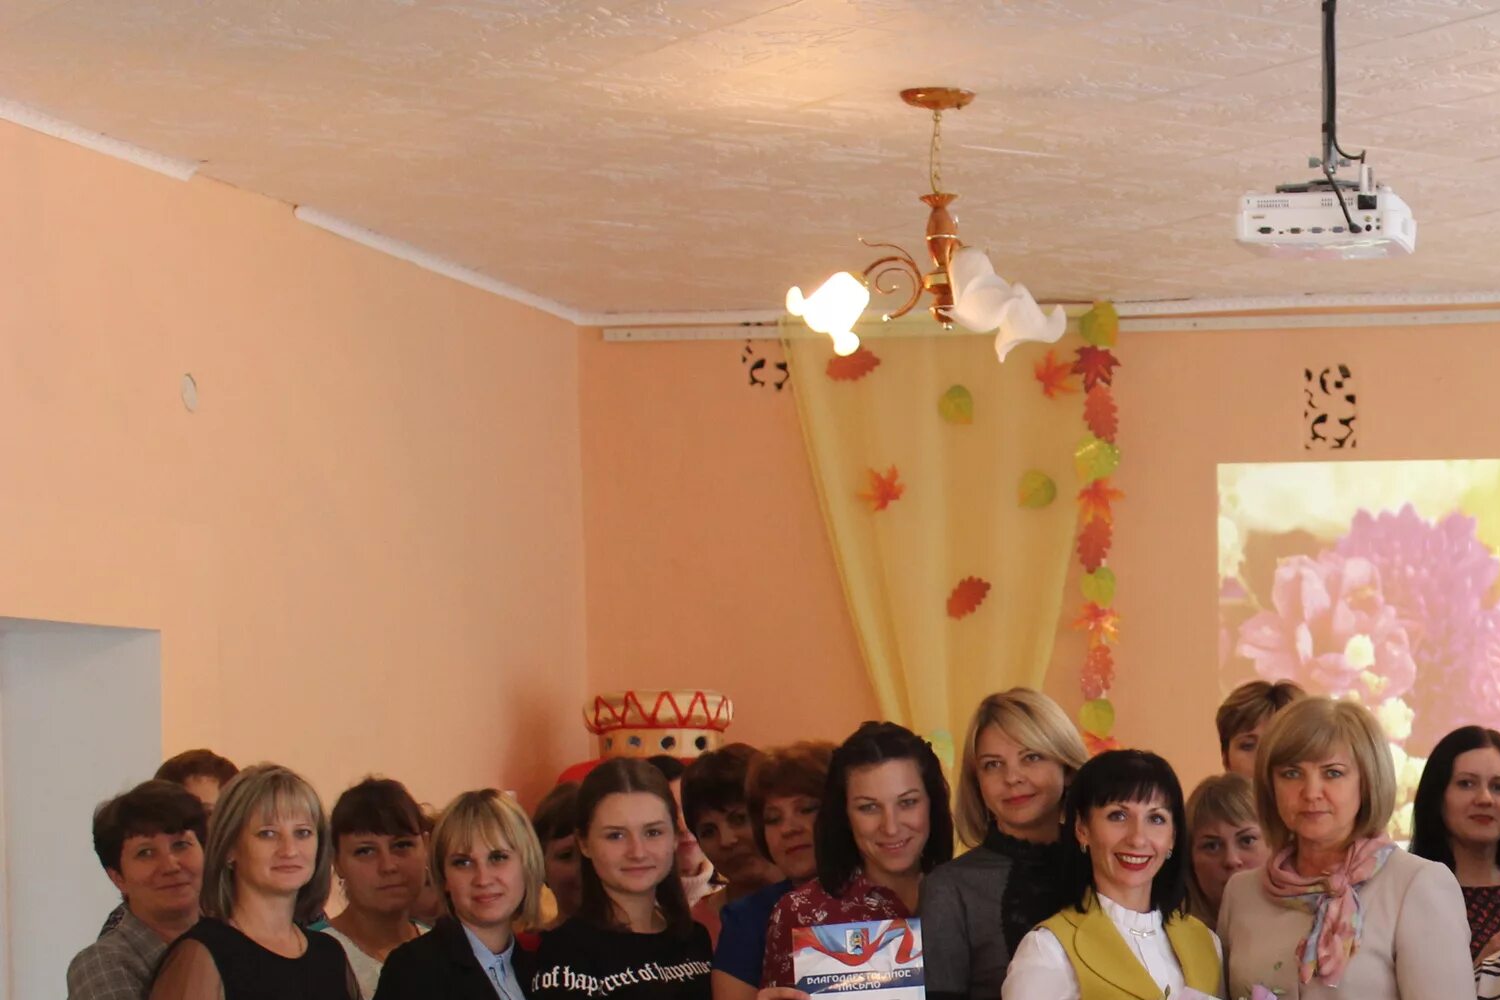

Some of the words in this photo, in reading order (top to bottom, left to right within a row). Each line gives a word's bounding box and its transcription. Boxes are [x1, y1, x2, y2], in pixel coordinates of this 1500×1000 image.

[542, 965, 560, 989] of
[638, 963, 658, 981] of
[838, 980, 881, 991] ПИСЬМО
